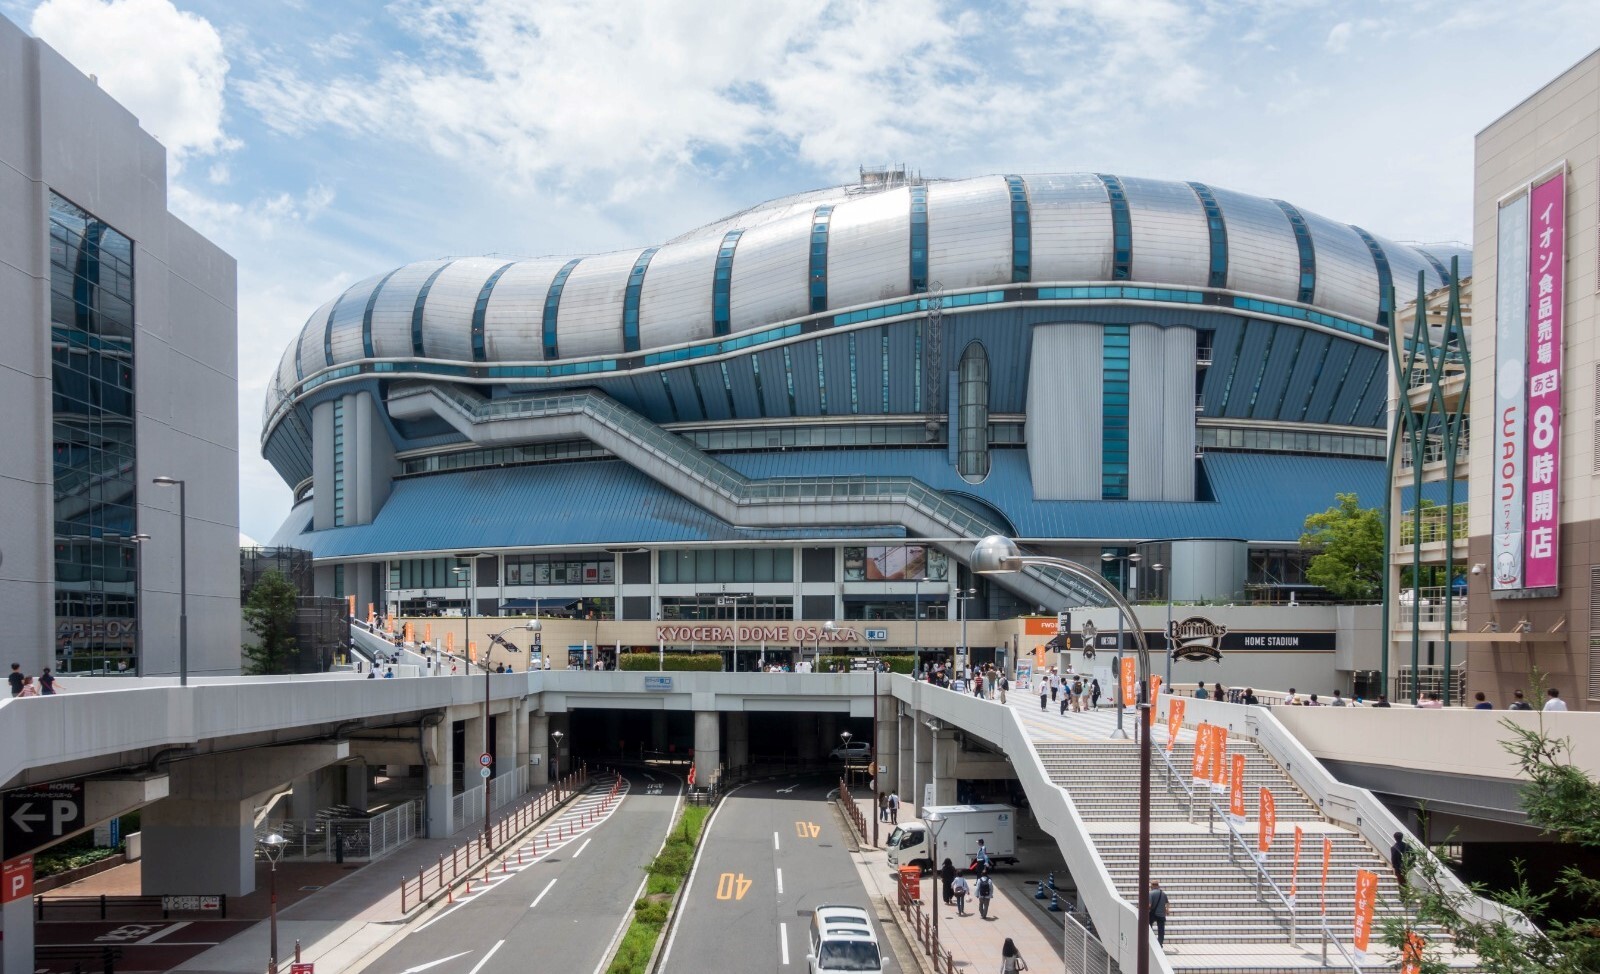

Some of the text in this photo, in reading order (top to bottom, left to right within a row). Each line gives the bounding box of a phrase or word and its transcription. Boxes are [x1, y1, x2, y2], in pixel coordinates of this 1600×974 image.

[1530, 203, 1556, 559] イオン食品売場 あさ 8時開店
[656, 626, 858, 642] KYOCERA DOME OSAKA
[867, 629, 885, 639] 東口
[1165, 620, 1227, 638] Buffaloes
[1245, 636, 1299, 646] HOME STADIUM
[52, 800, 78, 836] P
[795, 821, 821, 838] 40
[12, 875, 25, 897] P
[716, 872, 752, 900] 40
